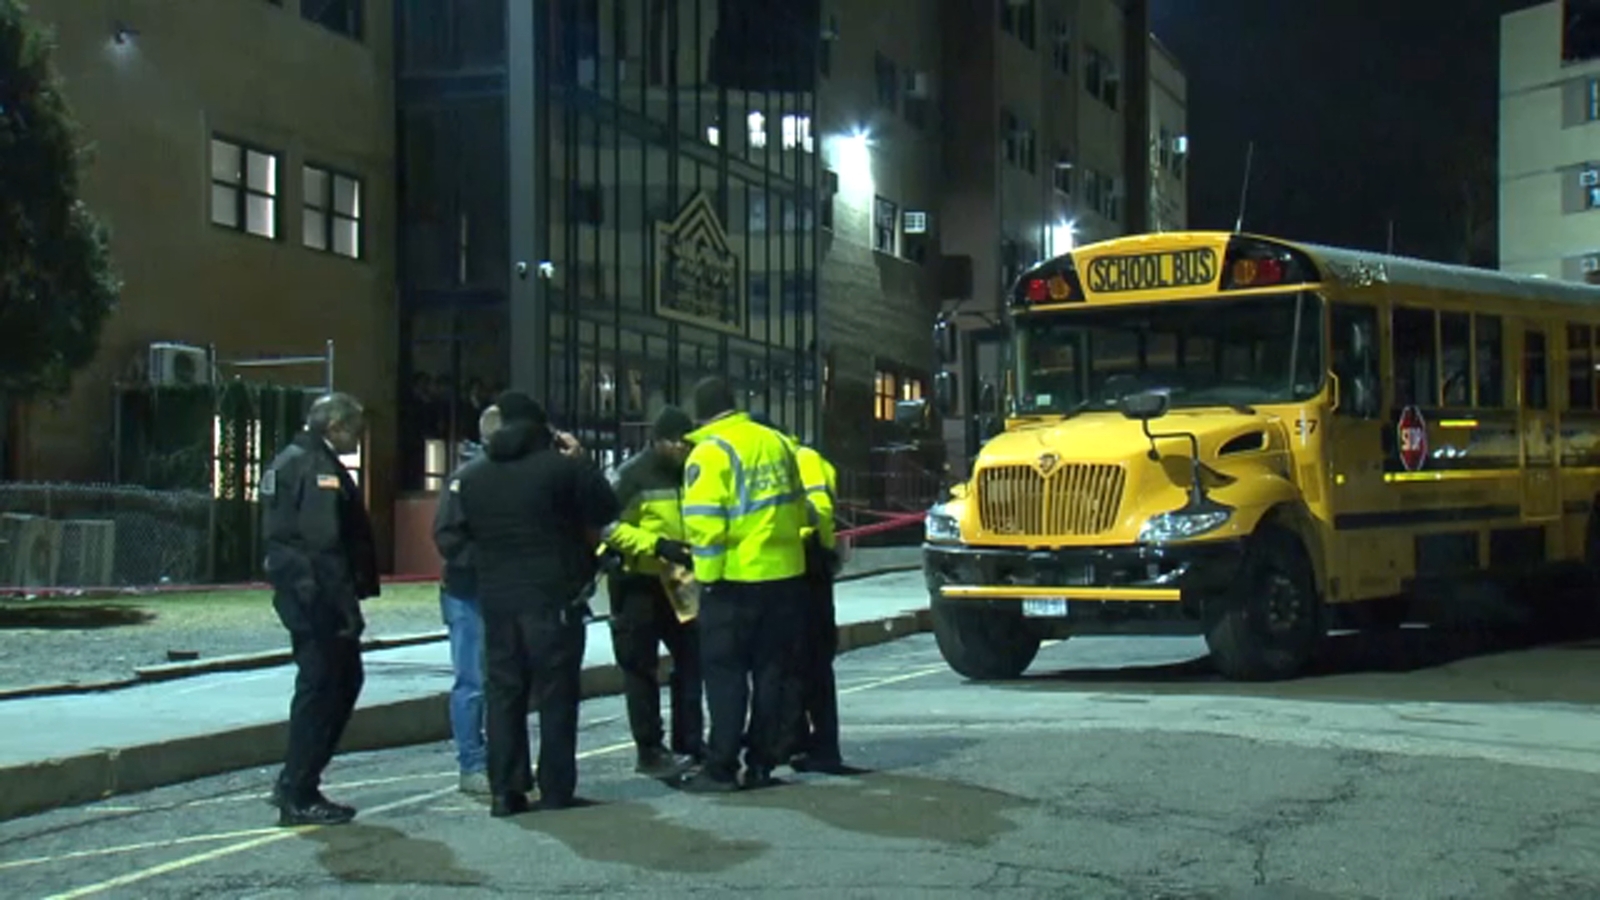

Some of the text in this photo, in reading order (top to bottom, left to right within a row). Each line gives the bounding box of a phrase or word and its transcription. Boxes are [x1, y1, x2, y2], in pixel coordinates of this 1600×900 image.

[1093, 250, 1211, 289] SCHOOL BUS
[1294, 419, 1318, 435] 57
